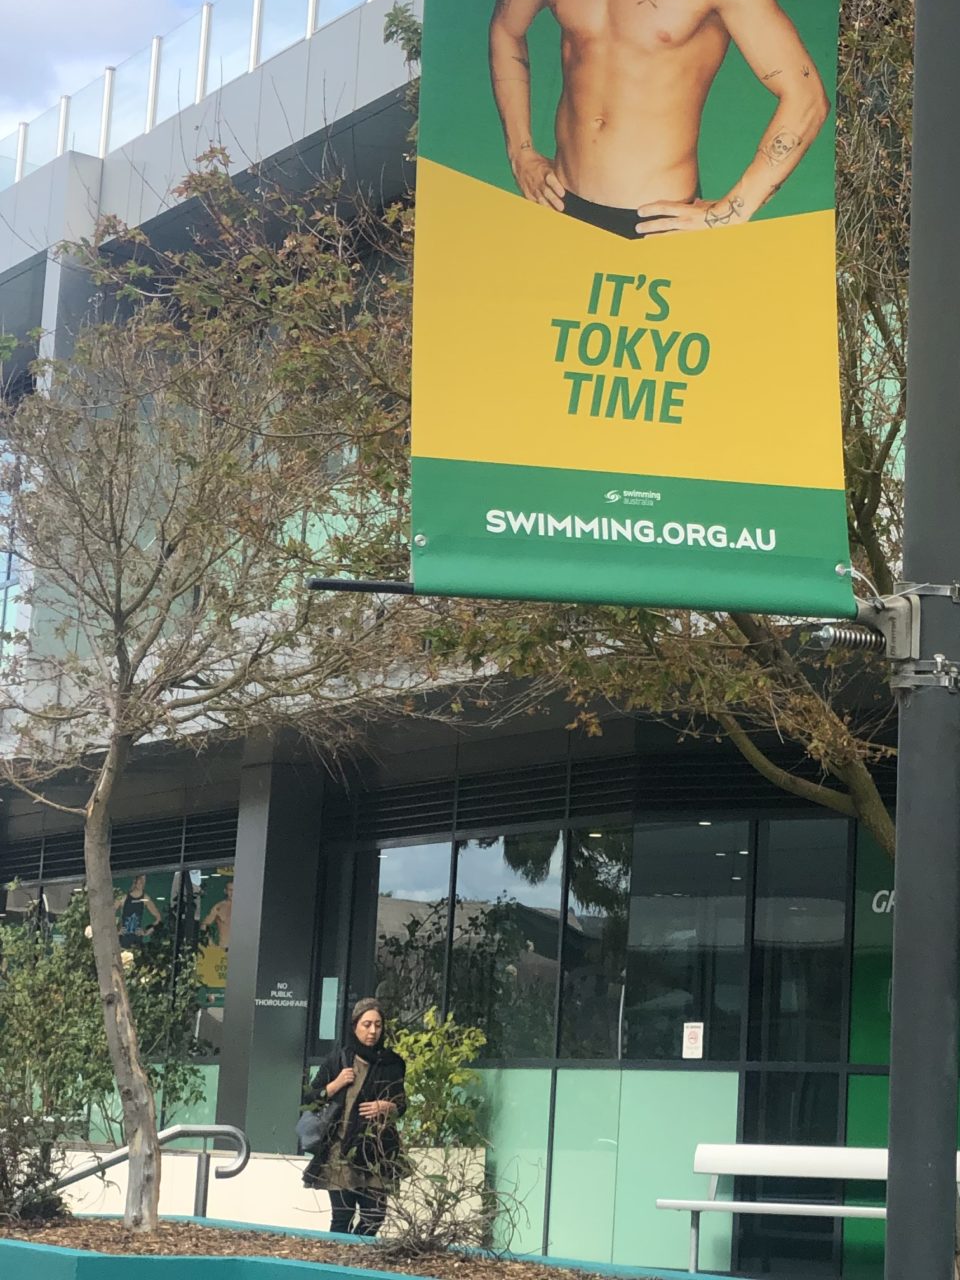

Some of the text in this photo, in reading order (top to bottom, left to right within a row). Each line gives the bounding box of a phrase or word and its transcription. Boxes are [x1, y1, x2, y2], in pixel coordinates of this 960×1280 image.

[587, 272, 672, 322] IT'S
[550, 318, 711, 376] TOKYO
[563, 371, 688, 425] TIME
[623, 489, 661, 501] swimming
[485, 509, 776, 551] SWIMMING.ORG.AU
[255, 999, 308, 1008] THOROUGHFARE
[270, 990, 293, 998] PUBLIC
